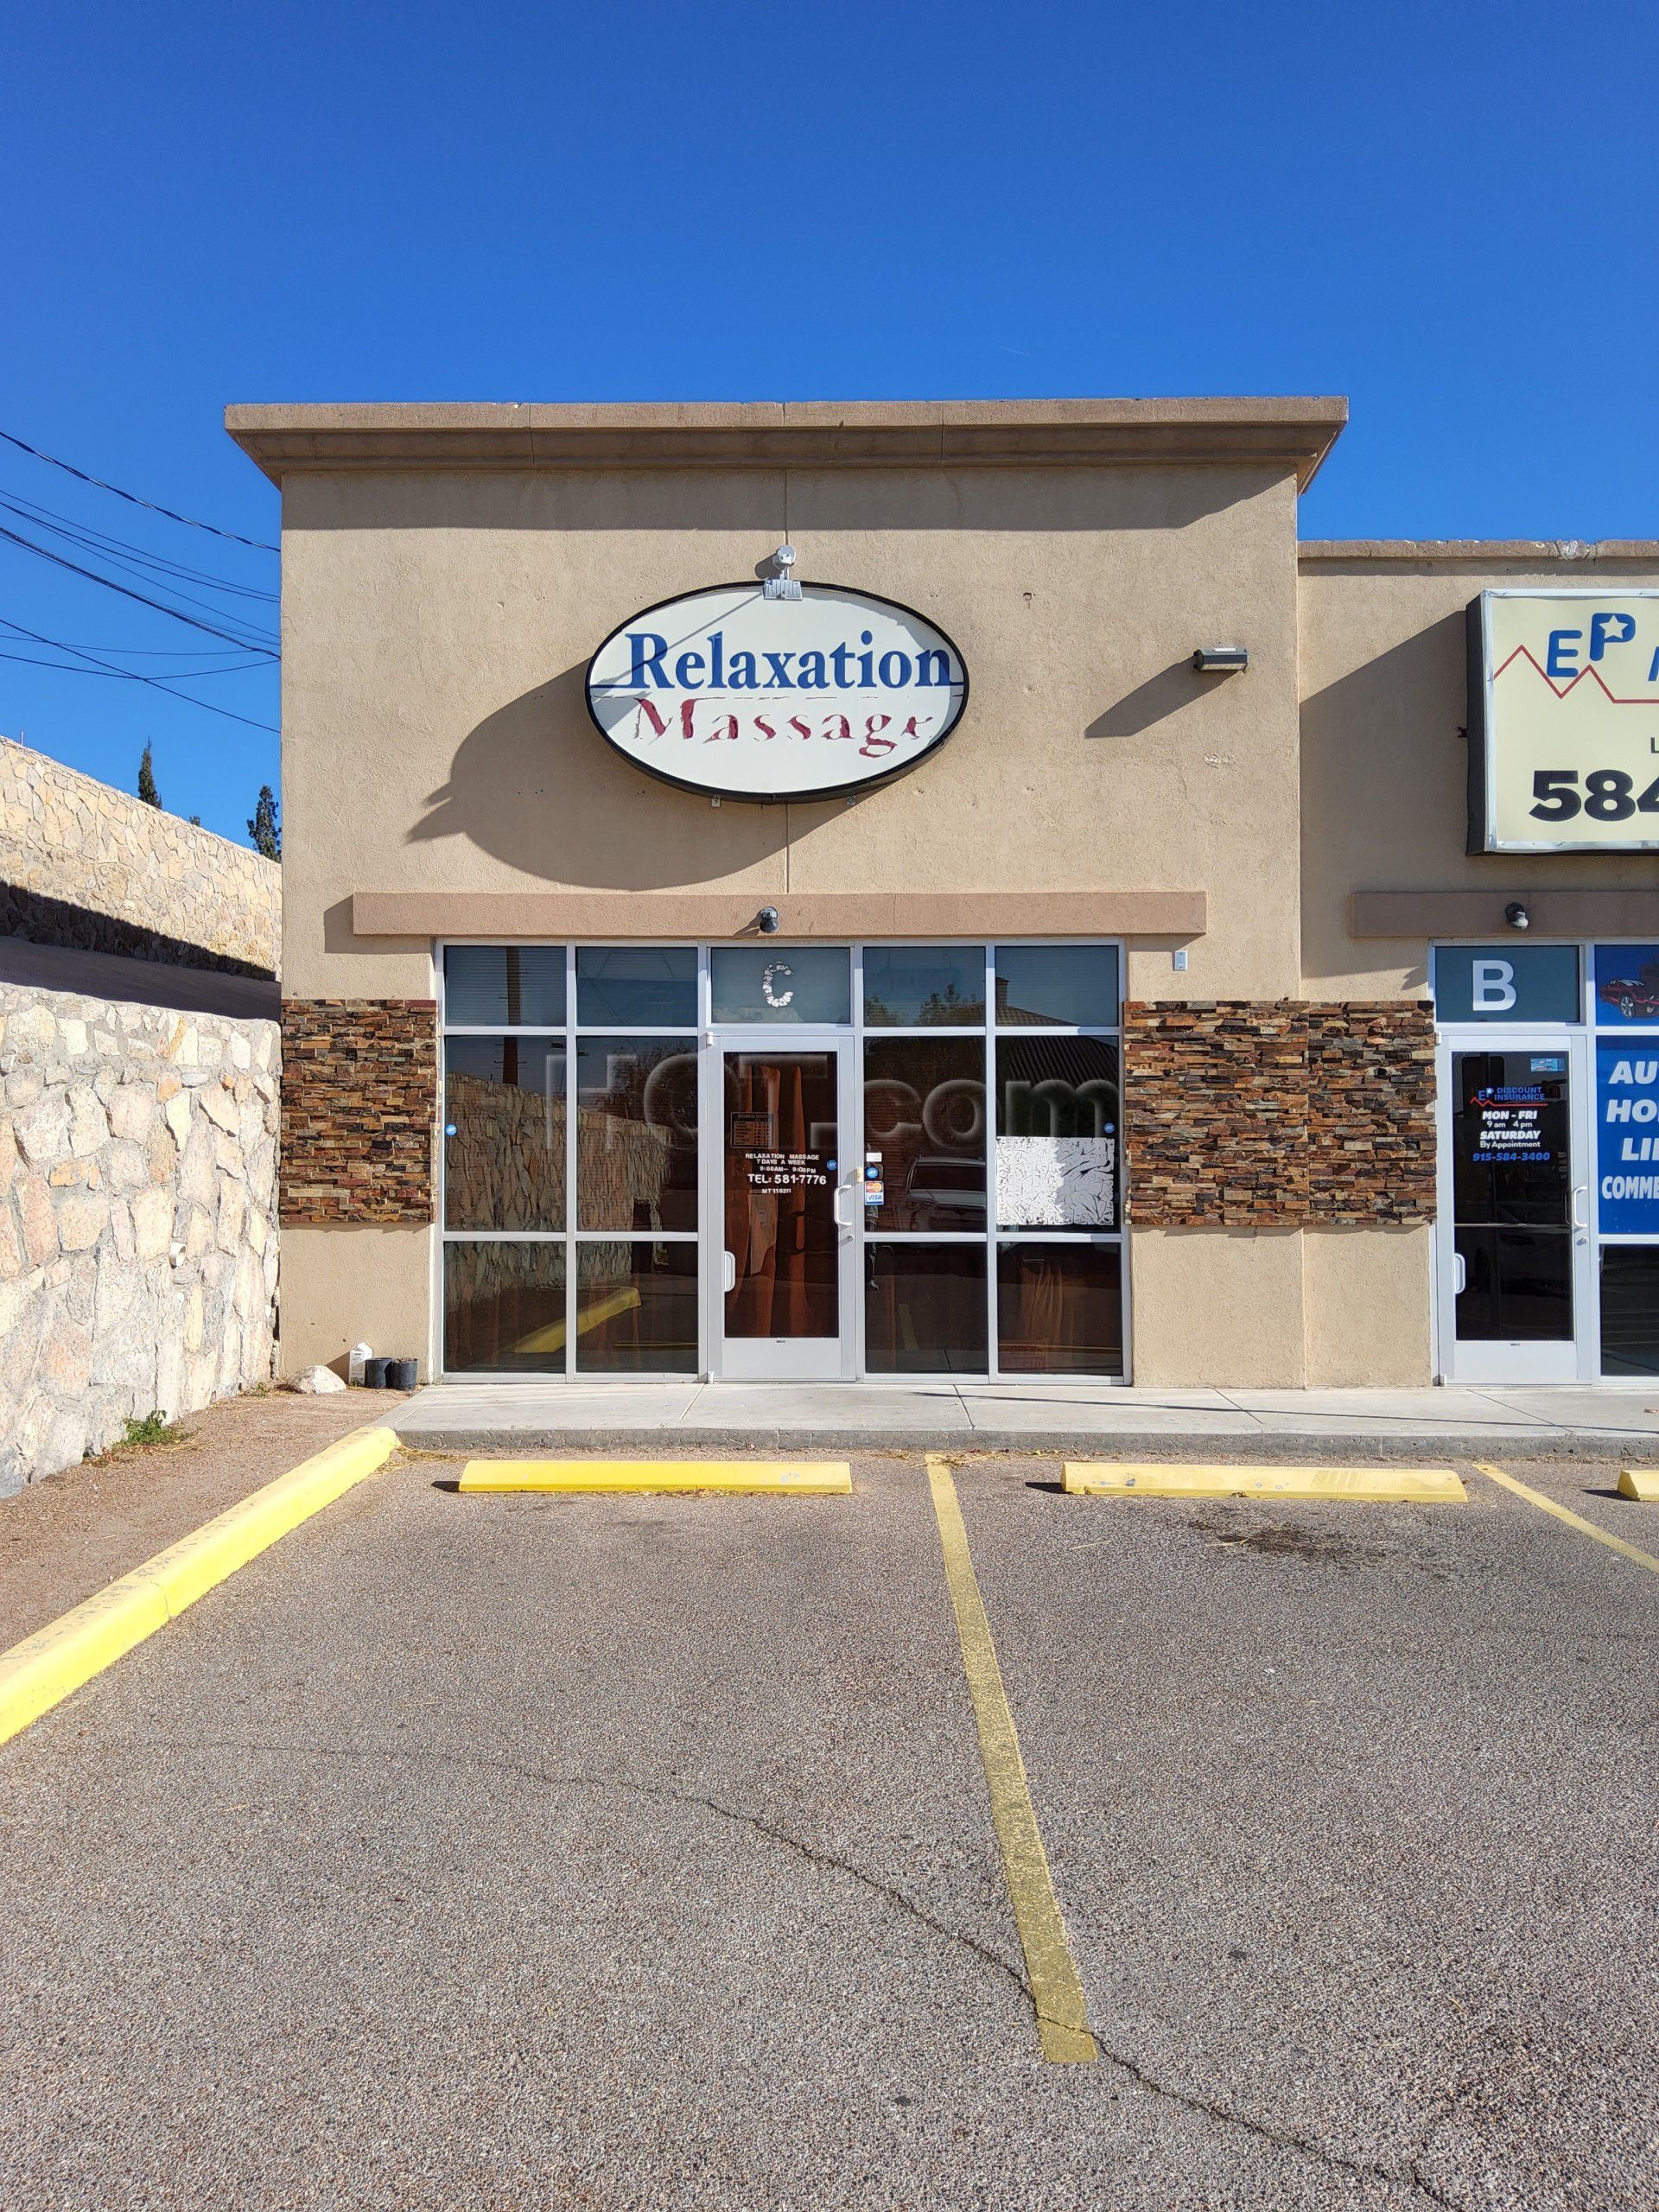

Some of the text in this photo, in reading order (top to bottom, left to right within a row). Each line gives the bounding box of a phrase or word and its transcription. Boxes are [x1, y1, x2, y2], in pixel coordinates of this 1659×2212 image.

[1547, 613, 1636, 677] EP
[625, 631, 954, 690] Relaxation
[762, 960, 794, 1007] C
[1472, 960, 1516, 1011] B
[1608, 1061, 1659, 1084] AU
[1482, 1110, 1510, 1120] MON
[1518, 1110, 1538, 1120] FRI
[1606, 1099, 1659, 1122] HO
[1479, 1130, 1541, 1140] SATURDAY
[1480, 1141, 1541, 1150] By Appointment
[1472, 1152, 1550, 1161] 915-584-3400
[774, 1174, 827, 1185] 581-7776
